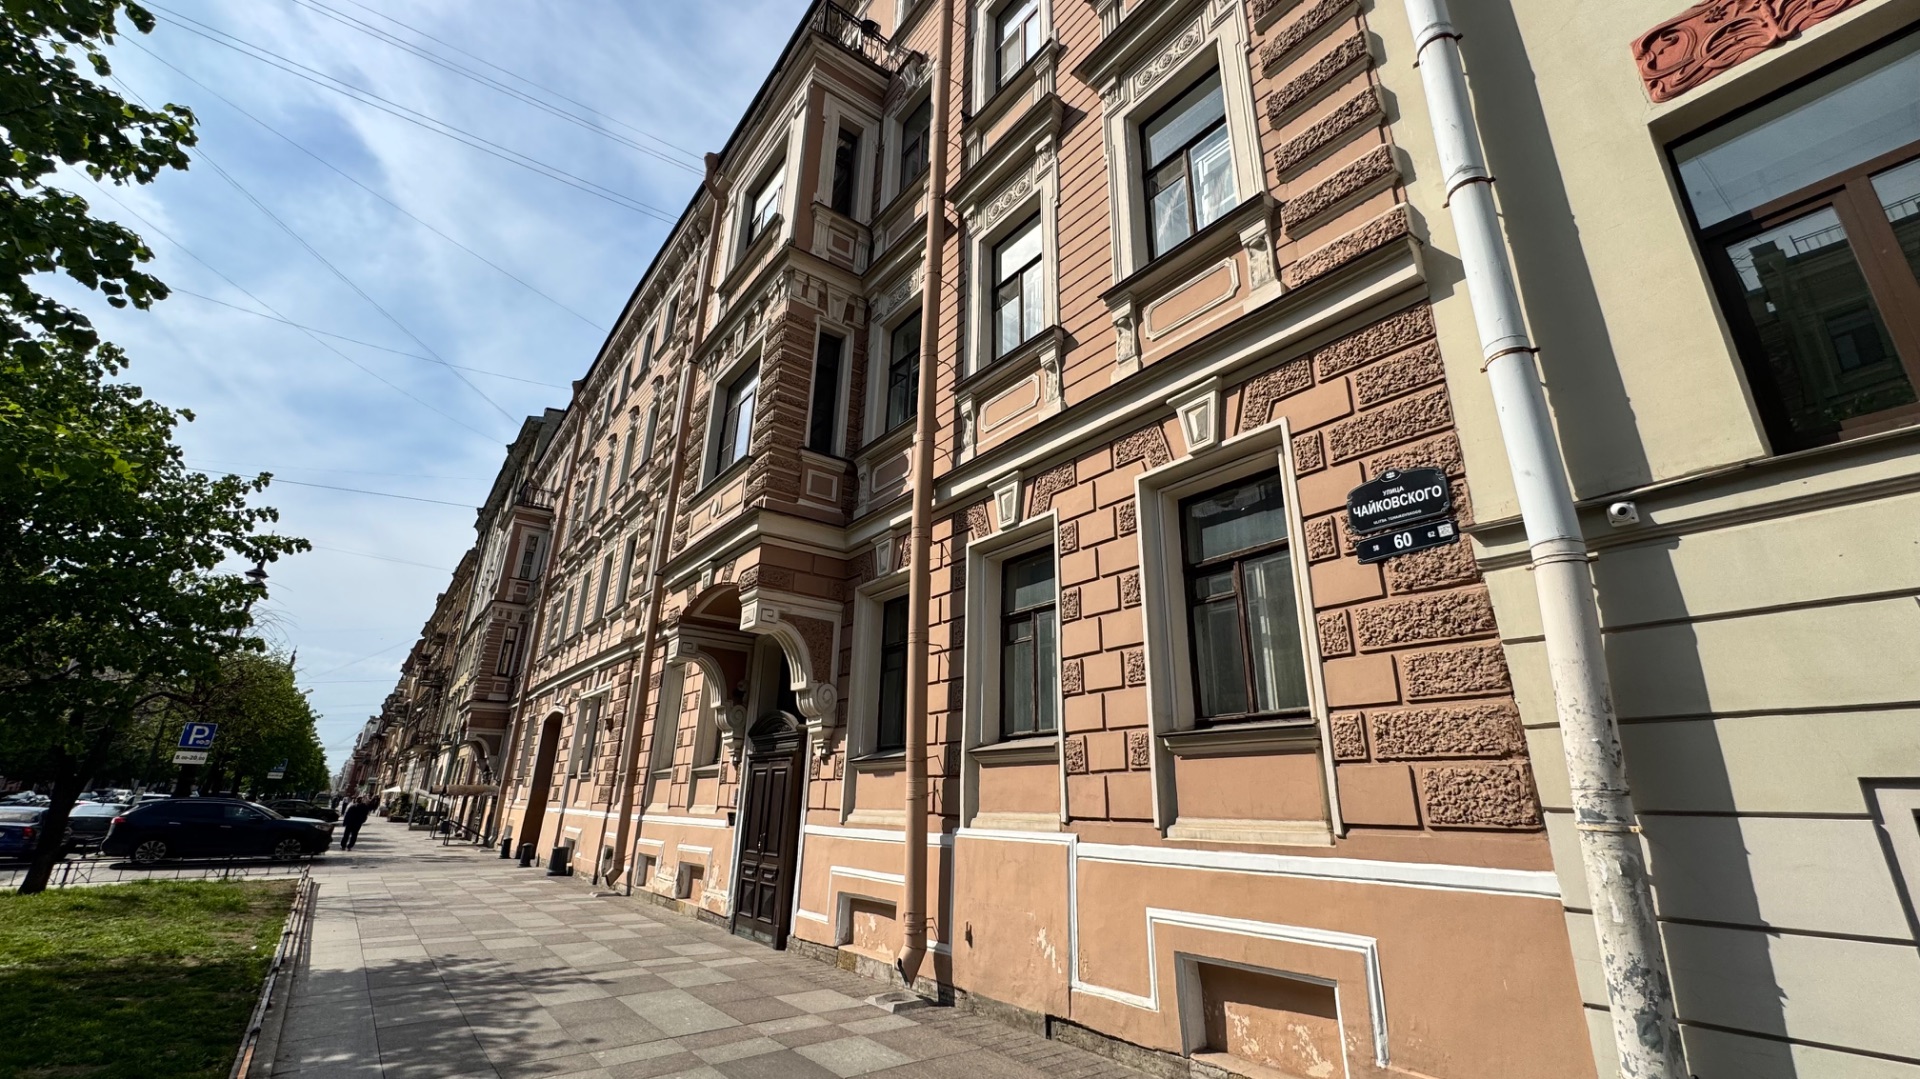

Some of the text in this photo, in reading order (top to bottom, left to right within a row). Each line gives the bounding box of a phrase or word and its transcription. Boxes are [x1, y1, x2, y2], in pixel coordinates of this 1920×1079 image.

[1382, 485, 1405, 496] УЛИЦА
[1353, 485, 1442, 518] ЧАЙКОВСКОГО
[1394, 532, 1412, 549] 60
[188, 725, 210, 745] P
